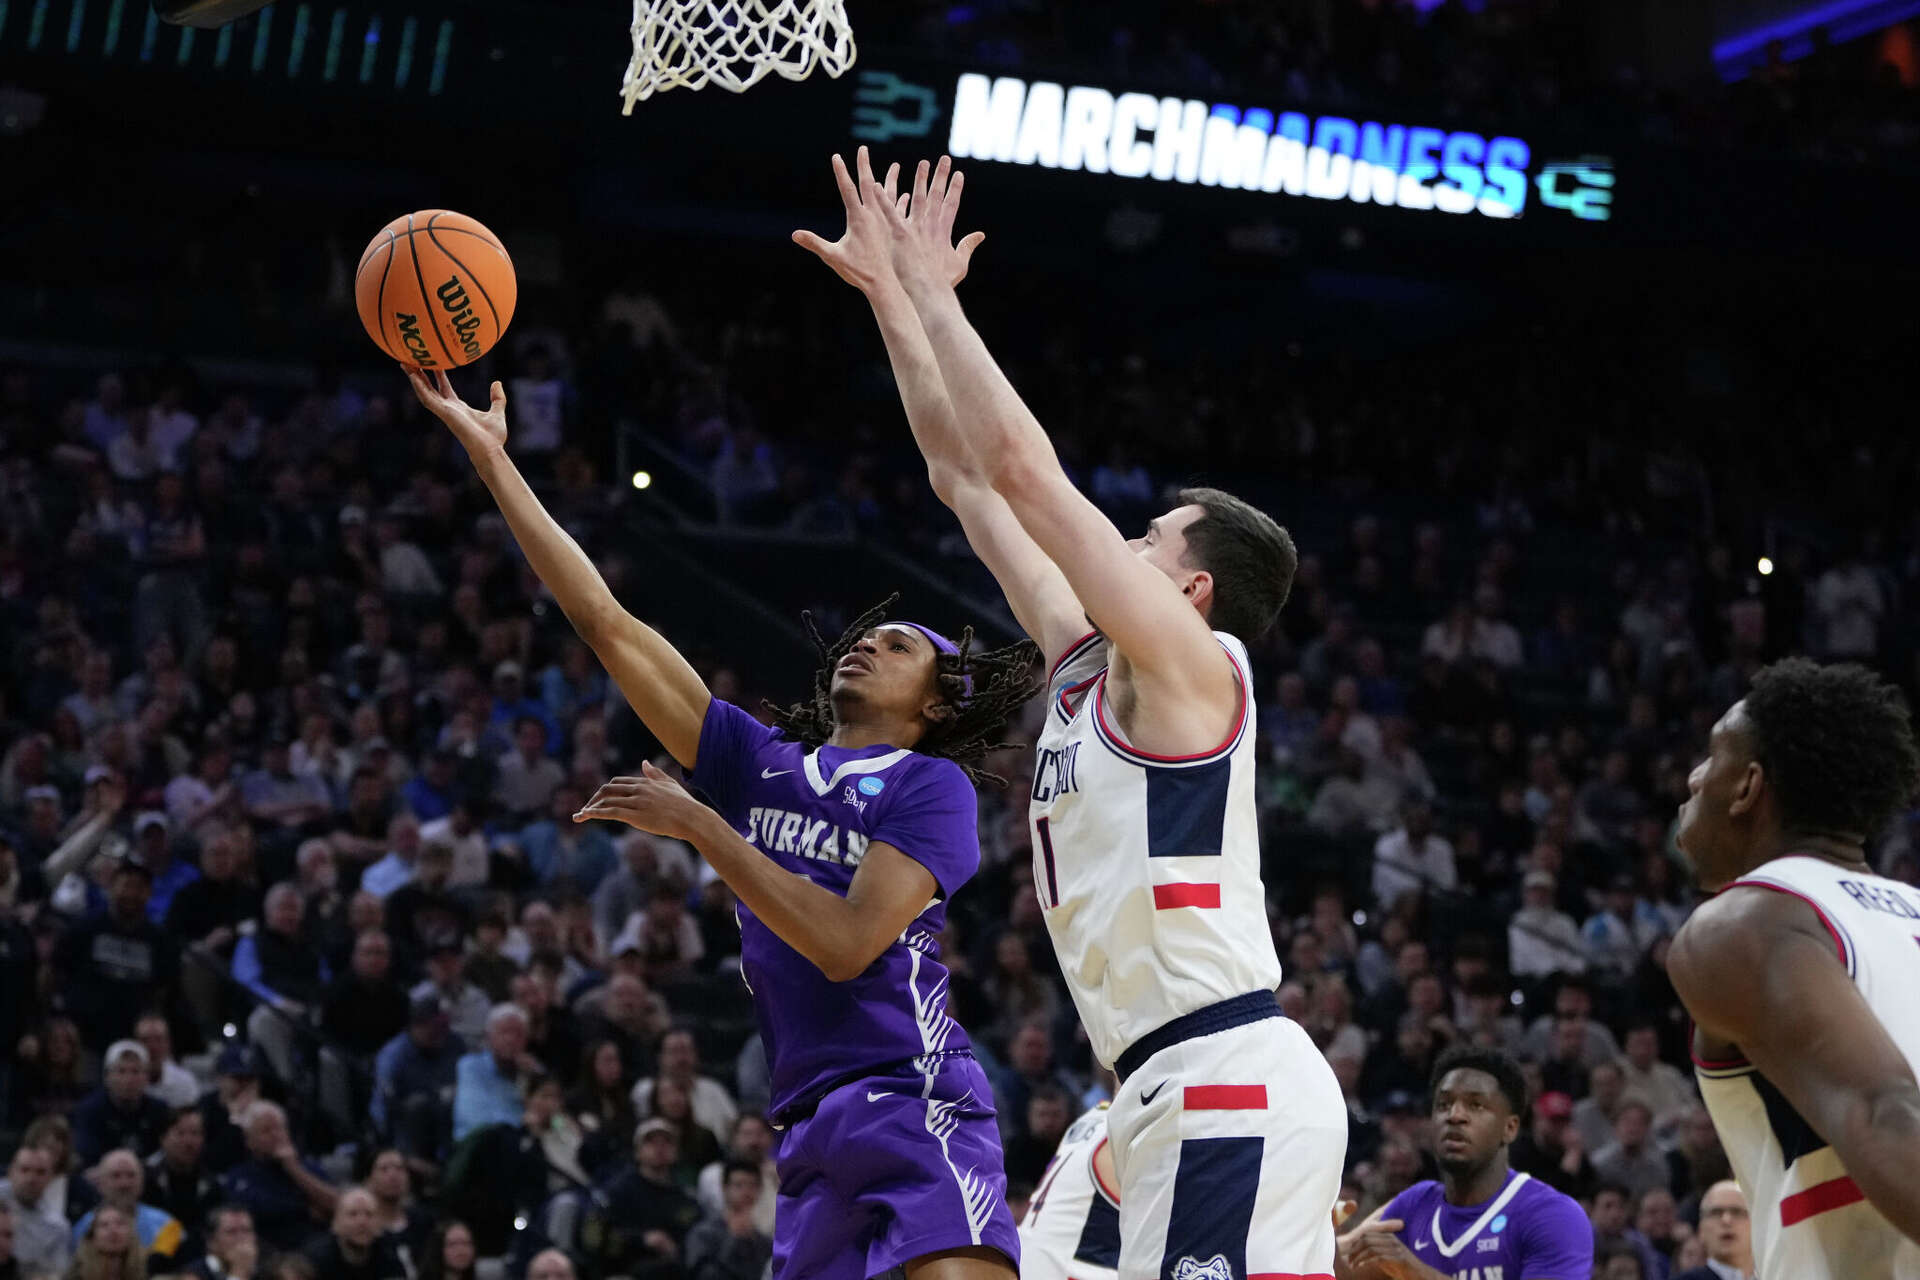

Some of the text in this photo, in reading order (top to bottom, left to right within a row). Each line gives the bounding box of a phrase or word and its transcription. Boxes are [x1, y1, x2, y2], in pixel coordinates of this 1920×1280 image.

[396, 311, 437, 368] NCAA
[436, 275, 482, 362] Wilson
[746, 806, 870, 867] FURMAN
